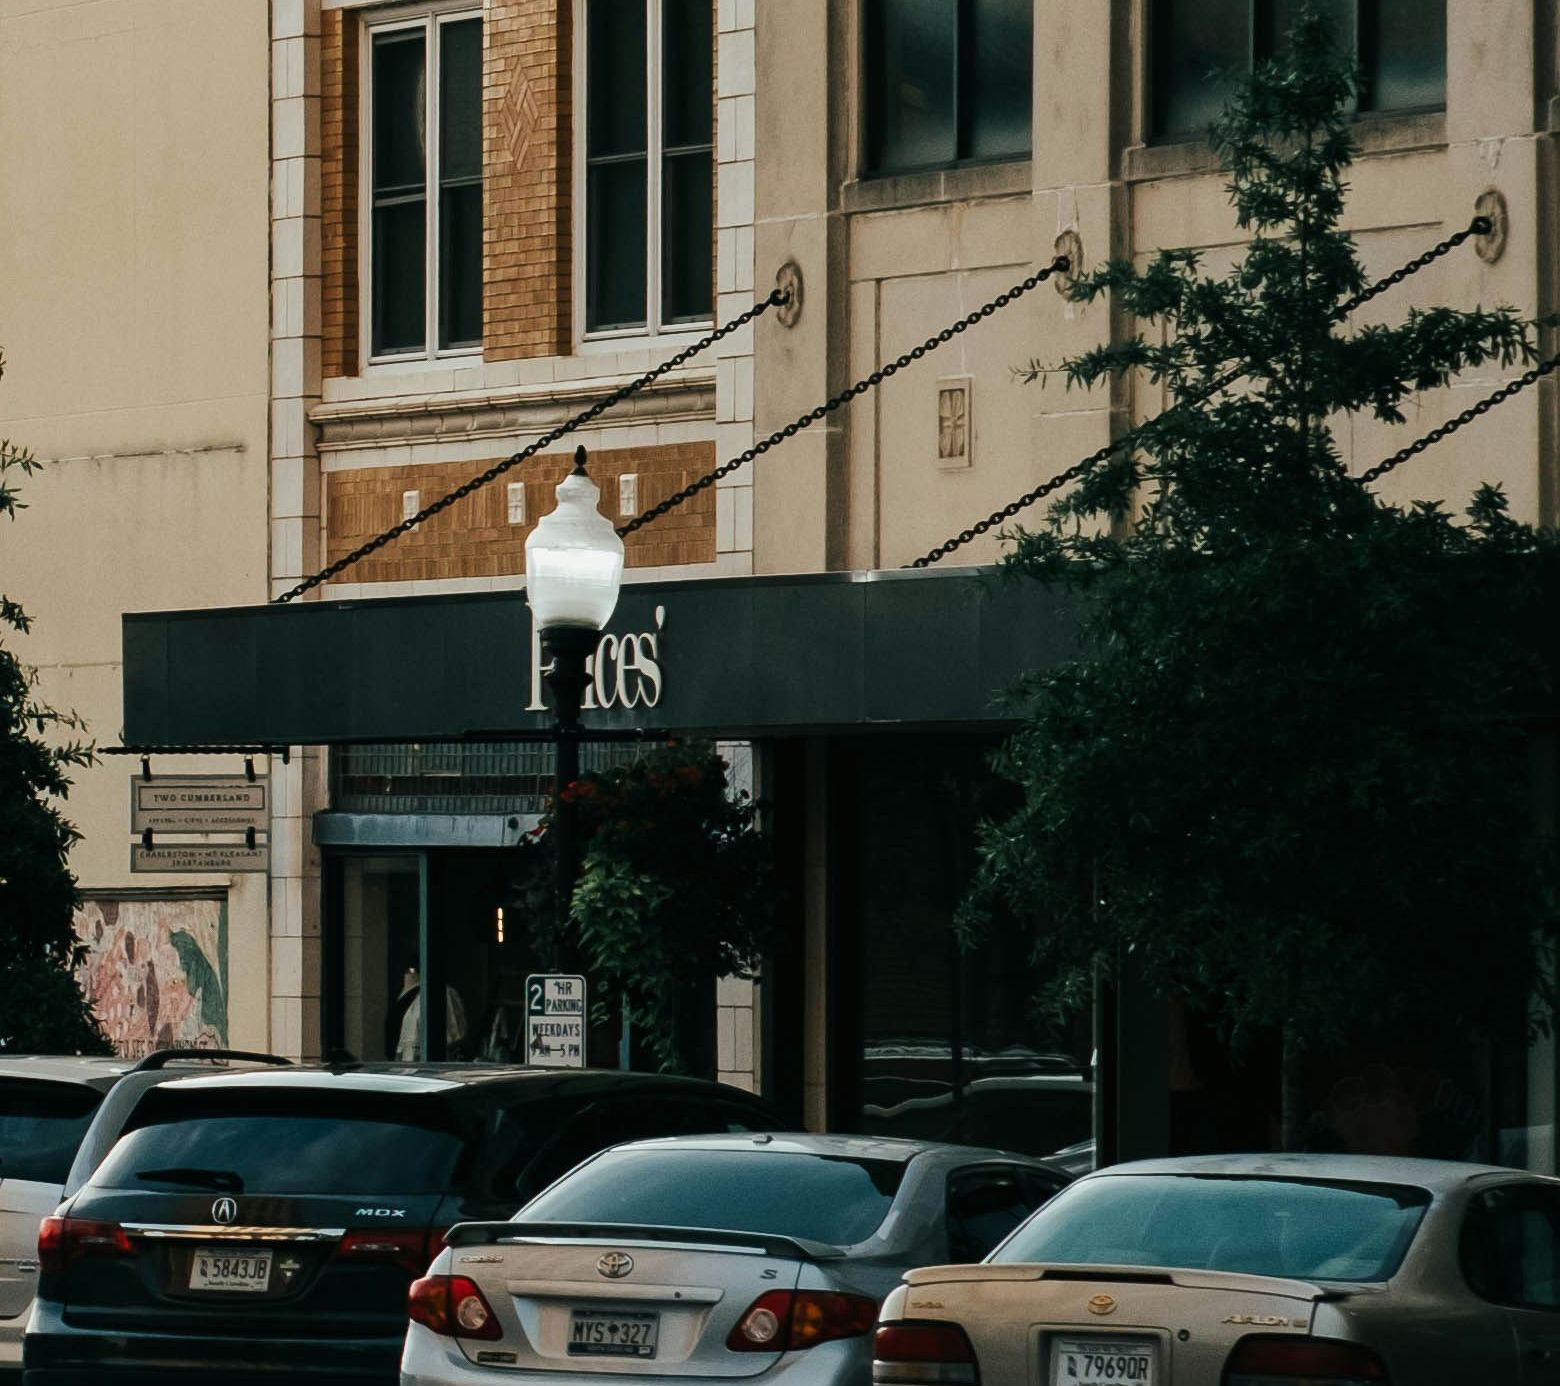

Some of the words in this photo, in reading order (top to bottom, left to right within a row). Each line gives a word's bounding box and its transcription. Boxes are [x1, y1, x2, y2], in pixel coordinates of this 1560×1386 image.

[153, 794, 177, 802] TWO
[180, 794, 251, 802] CUMBERLAND
[139, 850, 197, 859] CHARLESTON
[530, 983, 543, 1010] 2
[545, 999, 583, 1013] PARKING
[531, 1023, 581, 1038] WEEKDAYS
[355, 1208, 407, 1218] MDX
[211, 1258, 268, 1280] 5843JB
[620, 1323, 652, 1345] 327
